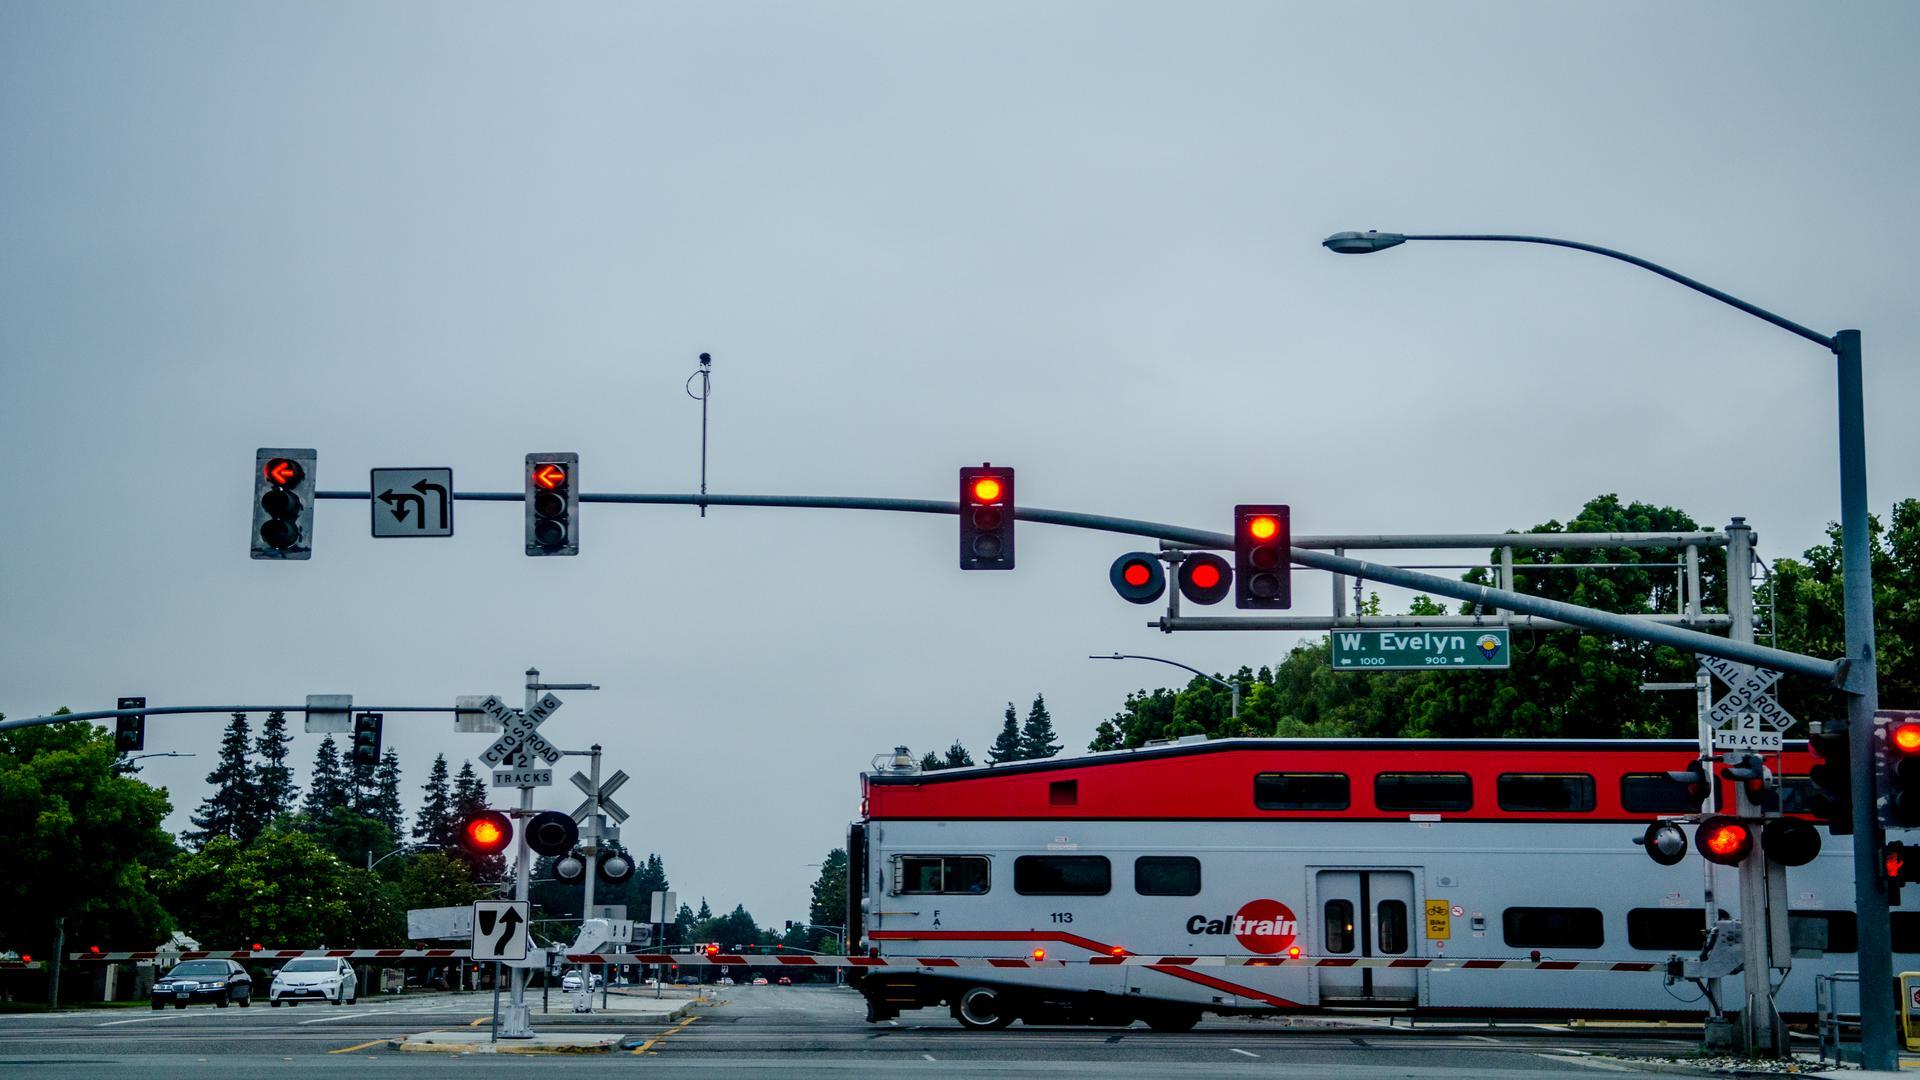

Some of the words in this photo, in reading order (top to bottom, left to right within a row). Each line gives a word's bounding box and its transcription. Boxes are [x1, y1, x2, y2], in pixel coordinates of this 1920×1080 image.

[1340, 633, 1367, 652] W.
[1380, 633, 1465, 654] Evelyn
[1360, 657, 1386, 666] 1000
[1425, 656, 1447, 665] 900
[1753, 696, 1790, 729] ROAD
[1743, 715, 1755, 729] 2
[483, 699, 512, 726] RAIL
[526, 734, 558, 763] ROAD
[486, 699, 555, 761] CROSSING
[1719, 734, 1779, 746] TRACKS
[517, 756, 528, 768] 2
[496, 774, 549, 784] TRACKS
[1050, 912, 1073, 923] 113
[1186, 915, 1298, 936] Caltrain
